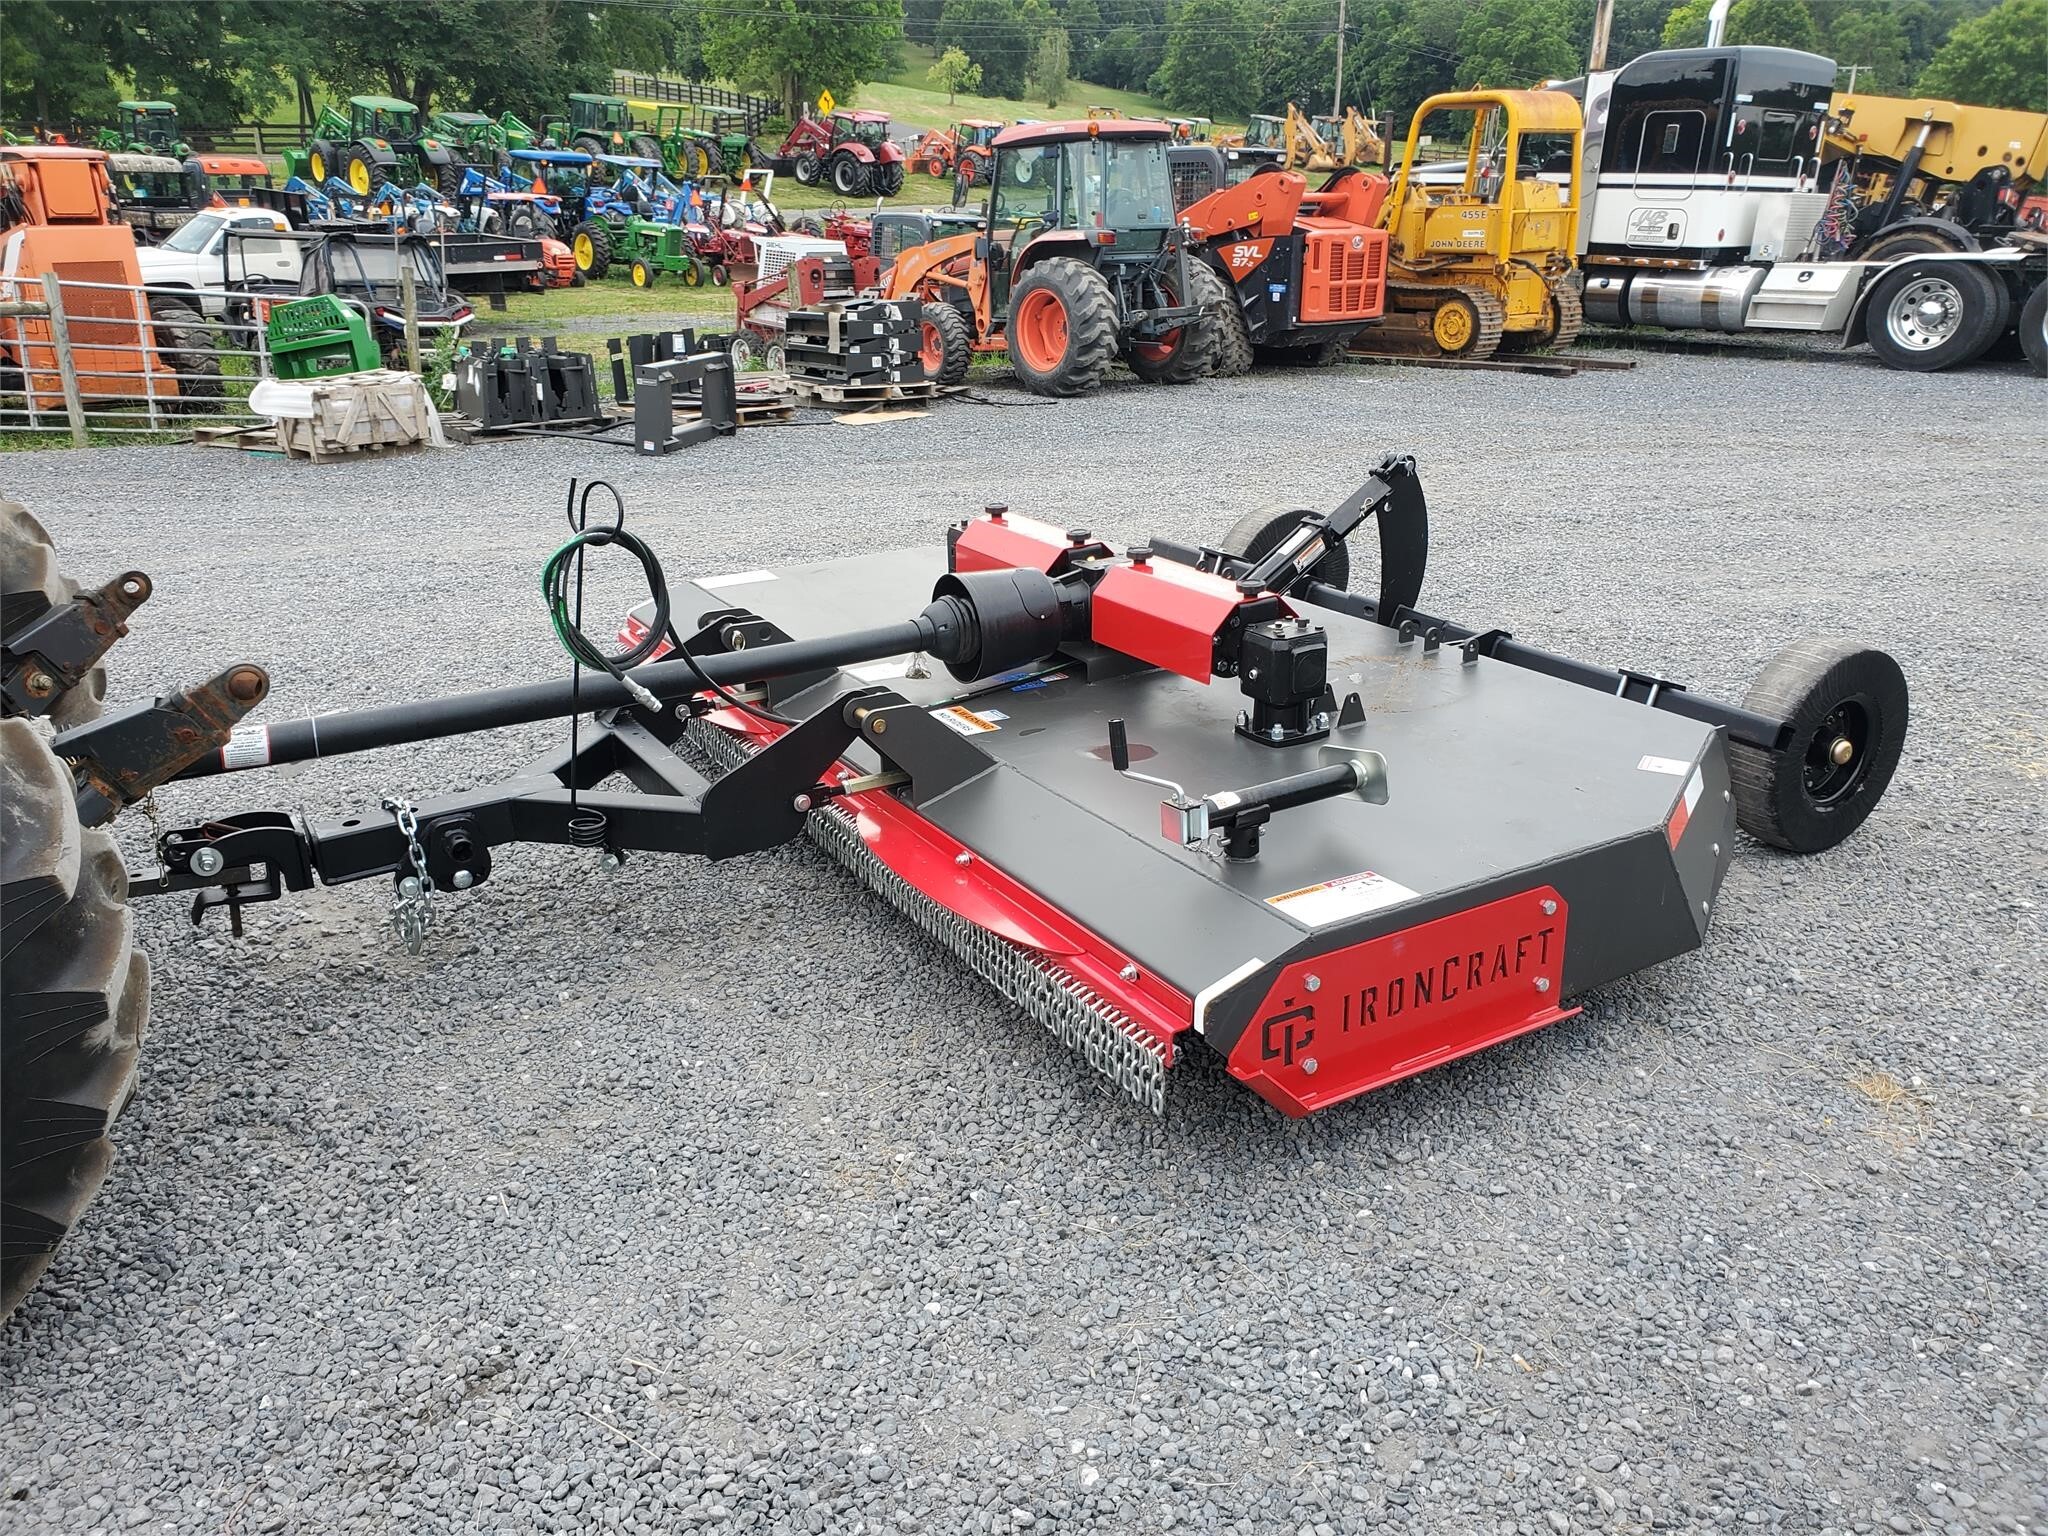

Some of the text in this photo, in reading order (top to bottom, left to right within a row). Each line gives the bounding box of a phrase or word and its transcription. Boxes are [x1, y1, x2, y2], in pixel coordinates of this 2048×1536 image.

[1461, 210, 1487, 219] 455E
[1430, 240, 1486, 248] JOHN DEERE
[1762, 244, 1770, 254] 5
[1232, 245, 1263, 258] SVL
[958, 708, 995, 730] WARNING
[1341, 927, 1555, 1033] IRONCRAFT
